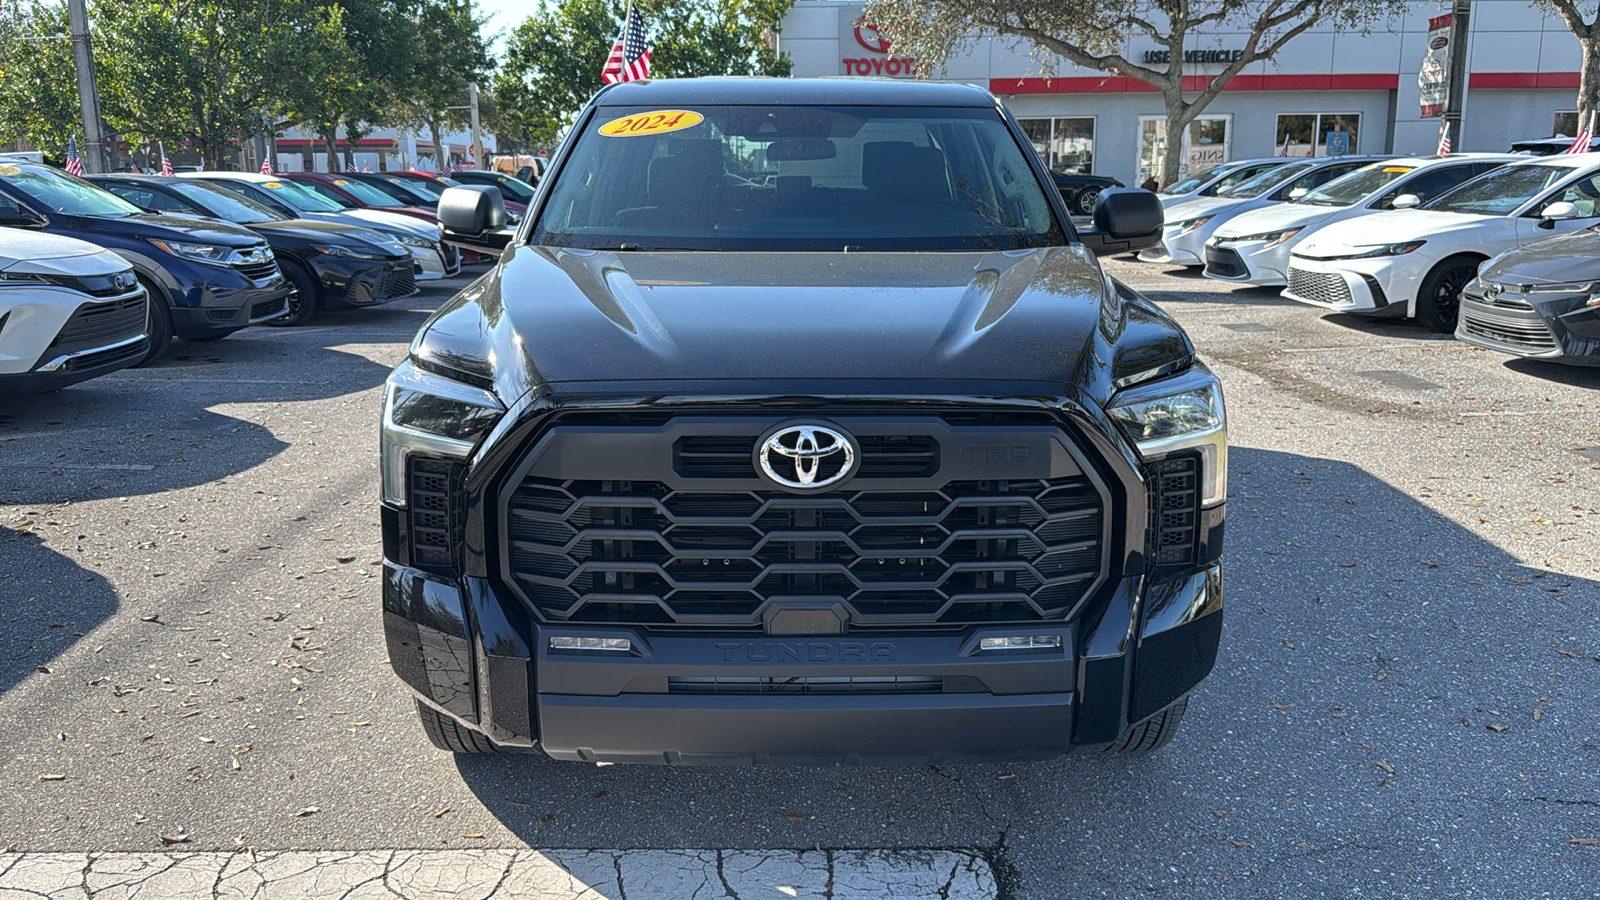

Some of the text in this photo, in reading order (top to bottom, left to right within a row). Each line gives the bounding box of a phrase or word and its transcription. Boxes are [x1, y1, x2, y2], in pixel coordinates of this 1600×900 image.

[1144, 50, 1170, 64] USE
[611, 112, 686, 135] 2024
[960, 446, 1032, 467] TRD
[715, 642, 897, 662] TUNDRA
